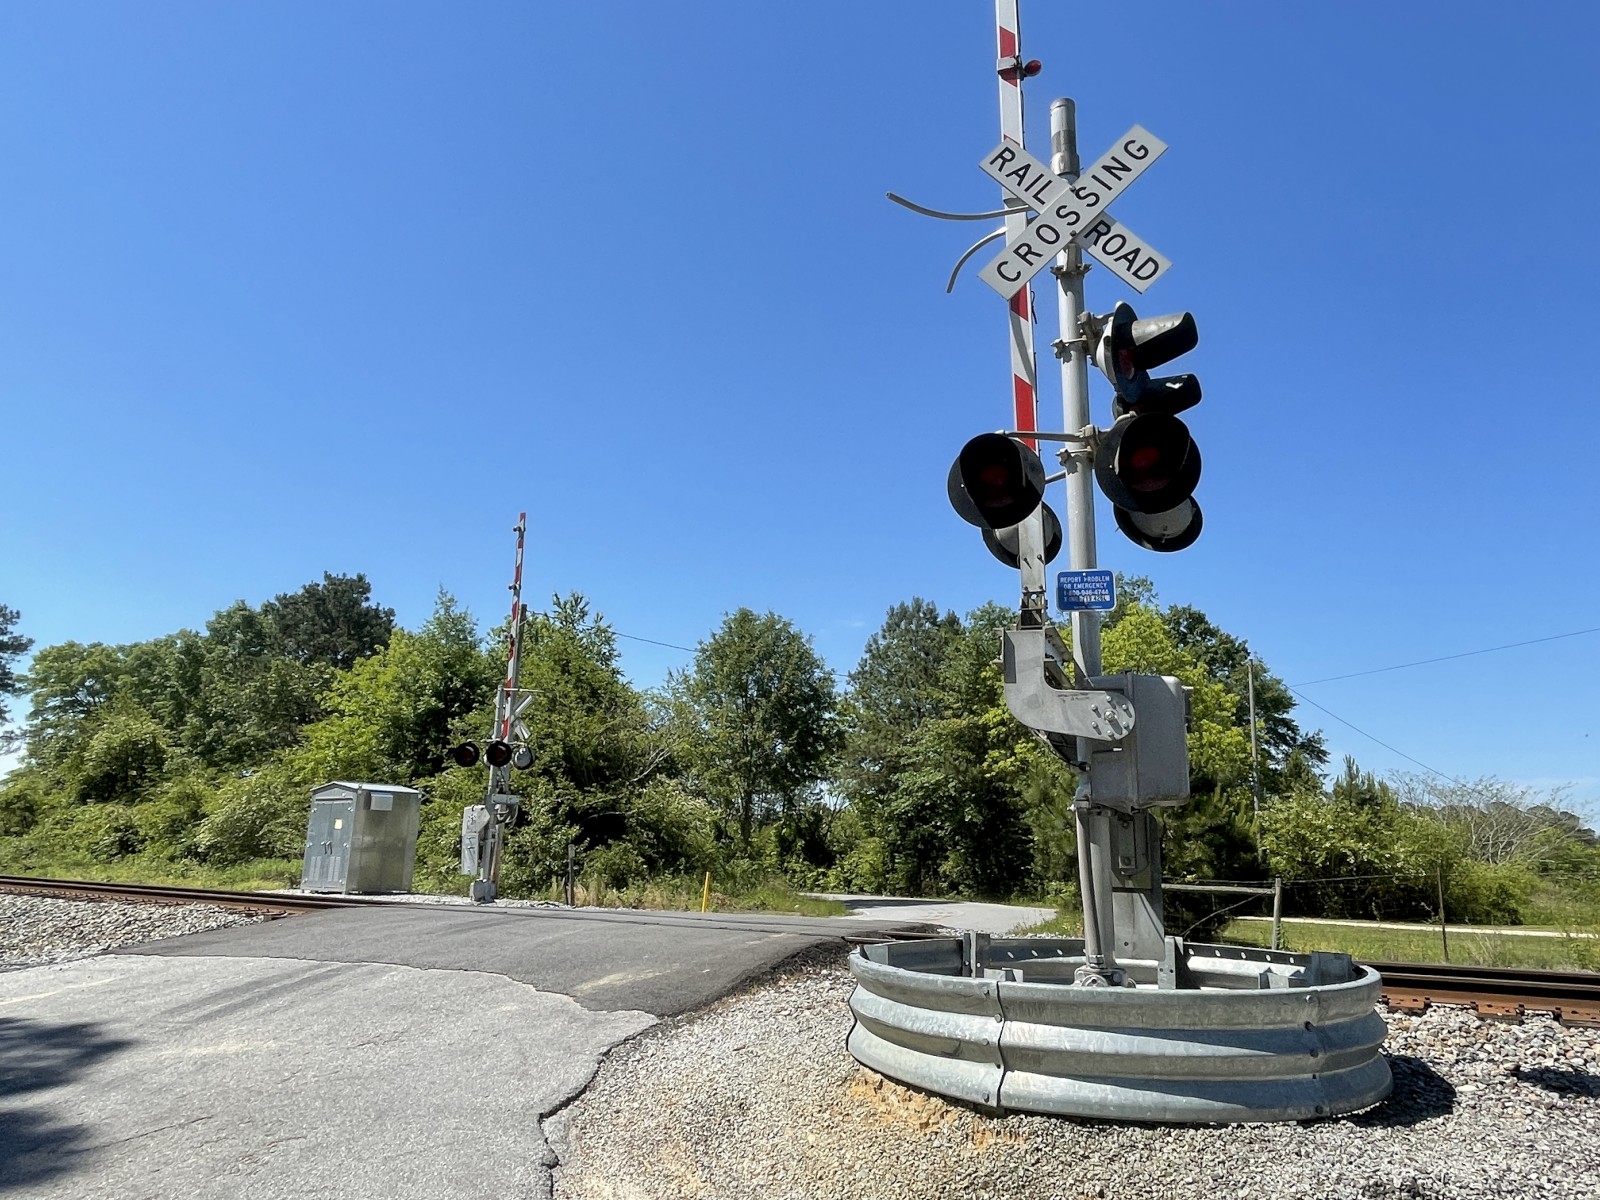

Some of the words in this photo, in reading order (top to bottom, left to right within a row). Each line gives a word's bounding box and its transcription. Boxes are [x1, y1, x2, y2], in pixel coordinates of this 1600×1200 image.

[989, 146, 1053, 206] RAIL
[1083, 219, 1160, 282] ROAD
[996, 139, 1150, 283] CROSSING
